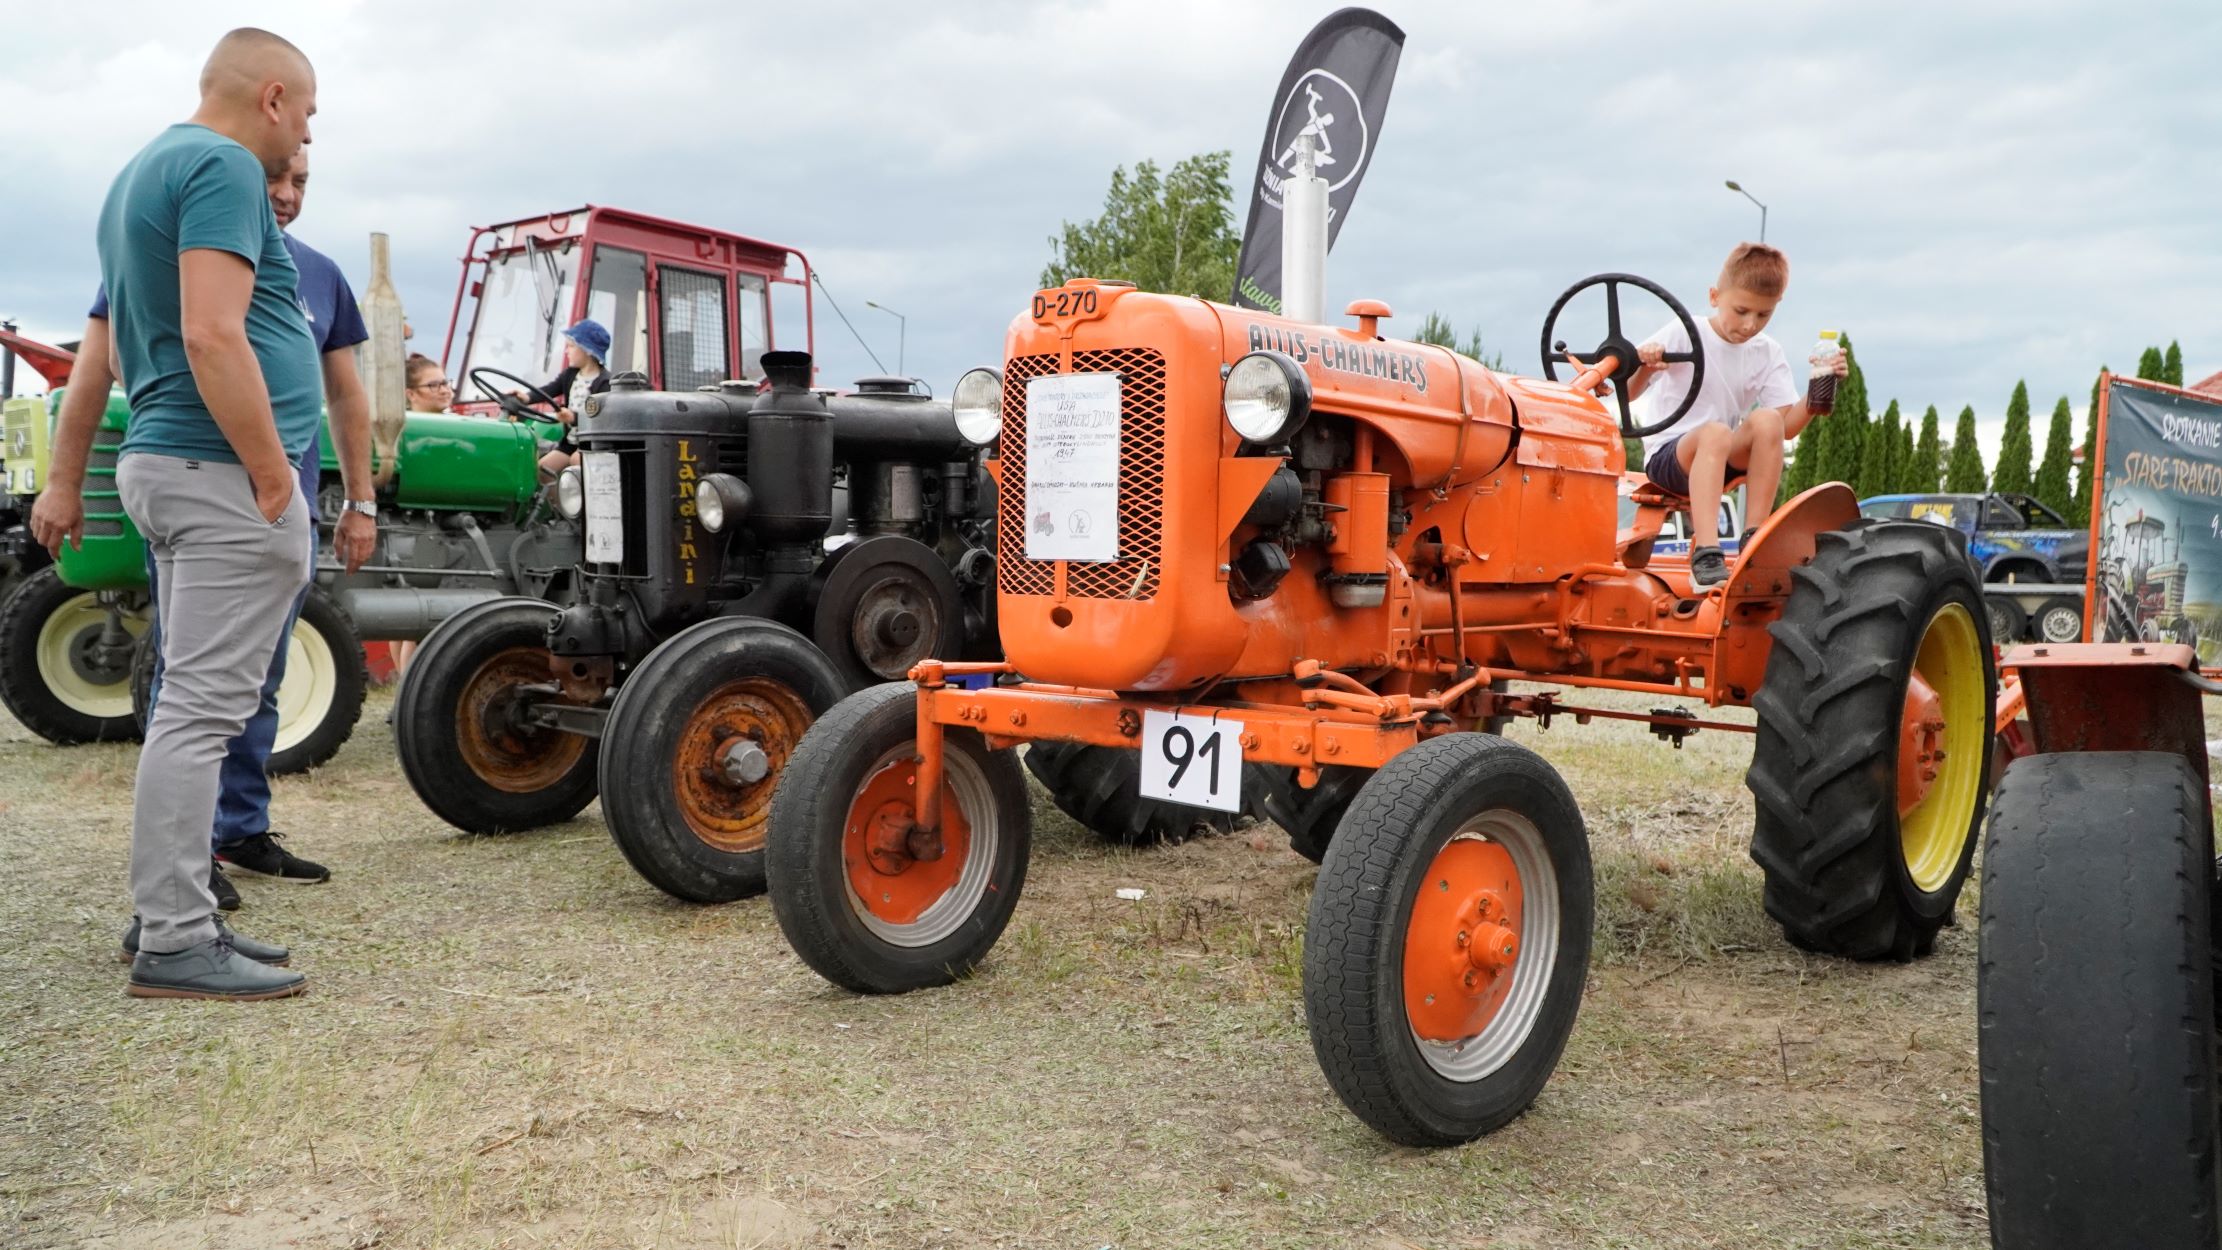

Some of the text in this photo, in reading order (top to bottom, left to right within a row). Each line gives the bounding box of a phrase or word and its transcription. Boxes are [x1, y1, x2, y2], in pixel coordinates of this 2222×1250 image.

[1033, 289, 1098, 319] D-270
[1248, 324, 1427, 394] ALLIS-CHALMERS
[1057, 399, 1076, 412] USA
[2162, 413, 2221, 448] SPOTKANIE
[2172, 458, 2222, 496] TRAKTO
[678, 440, 697, 584] Landini
[1162, 725, 1221, 796] 91
